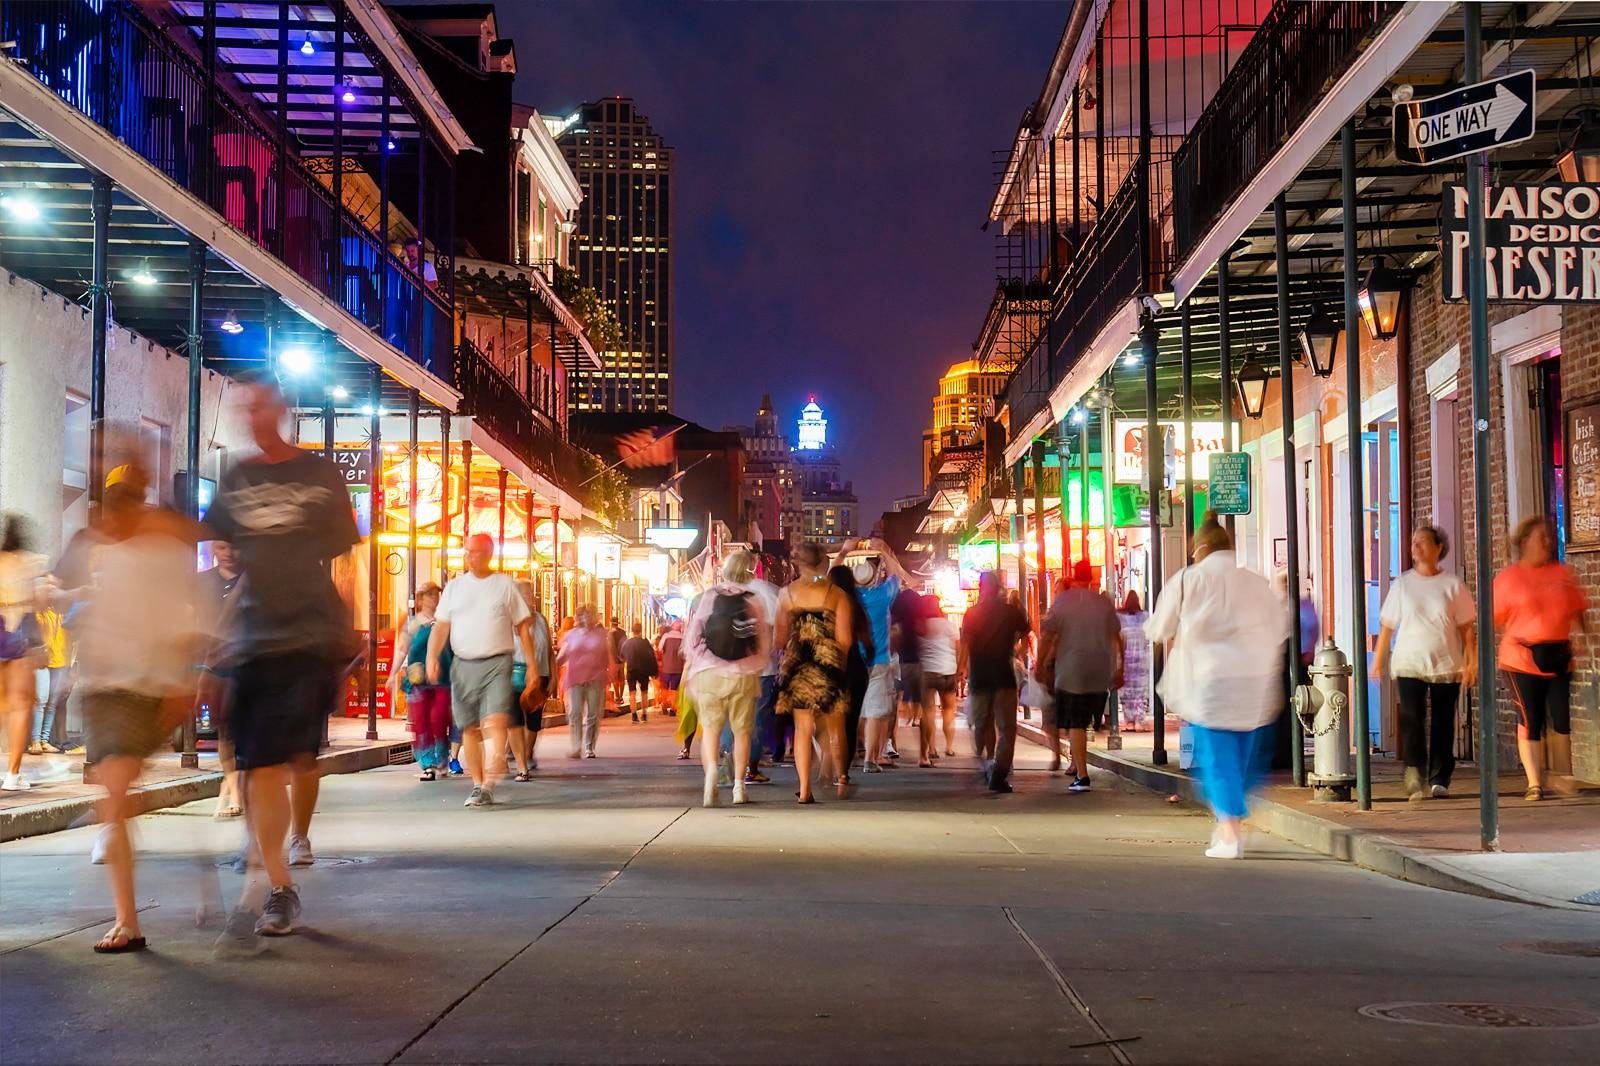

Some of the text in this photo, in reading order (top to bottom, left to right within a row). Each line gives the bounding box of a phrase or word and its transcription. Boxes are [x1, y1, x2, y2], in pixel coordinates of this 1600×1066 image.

[1415, 102, 1492, 145] ONE WAY
[1451, 185, 1600, 220] MAISO
[1575, 416, 1594, 441] Irish
[1572, 441, 1599, 465] Coffee
